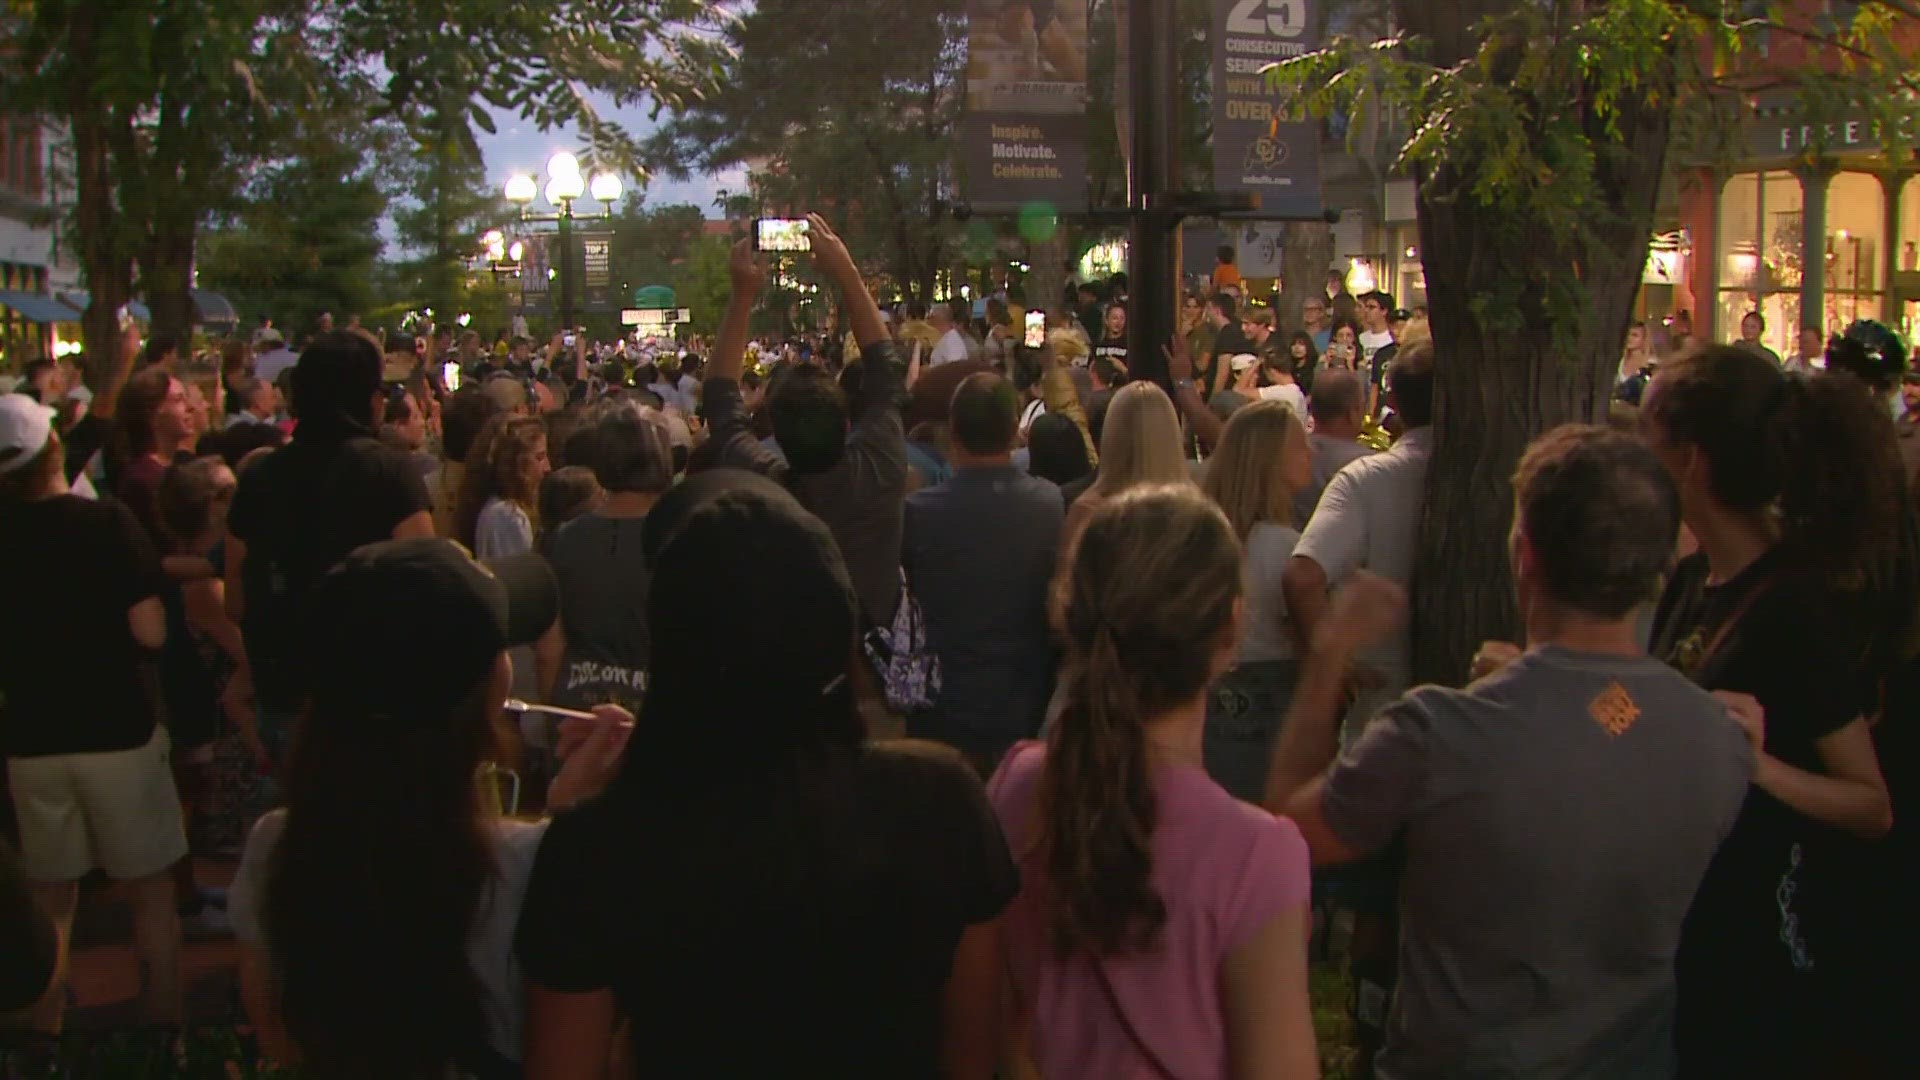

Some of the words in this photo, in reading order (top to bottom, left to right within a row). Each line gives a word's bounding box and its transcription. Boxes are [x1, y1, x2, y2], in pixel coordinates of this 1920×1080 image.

[1226, 0, 1305, 37] 25
[1225, 38, 1305, 56] CONSECUTIVE
[1226, 100, 1272, 120] OVER
[992, 123, 1044, 141] Inspire.
[992, 143, 1056, 159] Motivate.
[993, 162, 1062, 179] Celebrate.
[567, 661, 648, 690] COLORA
